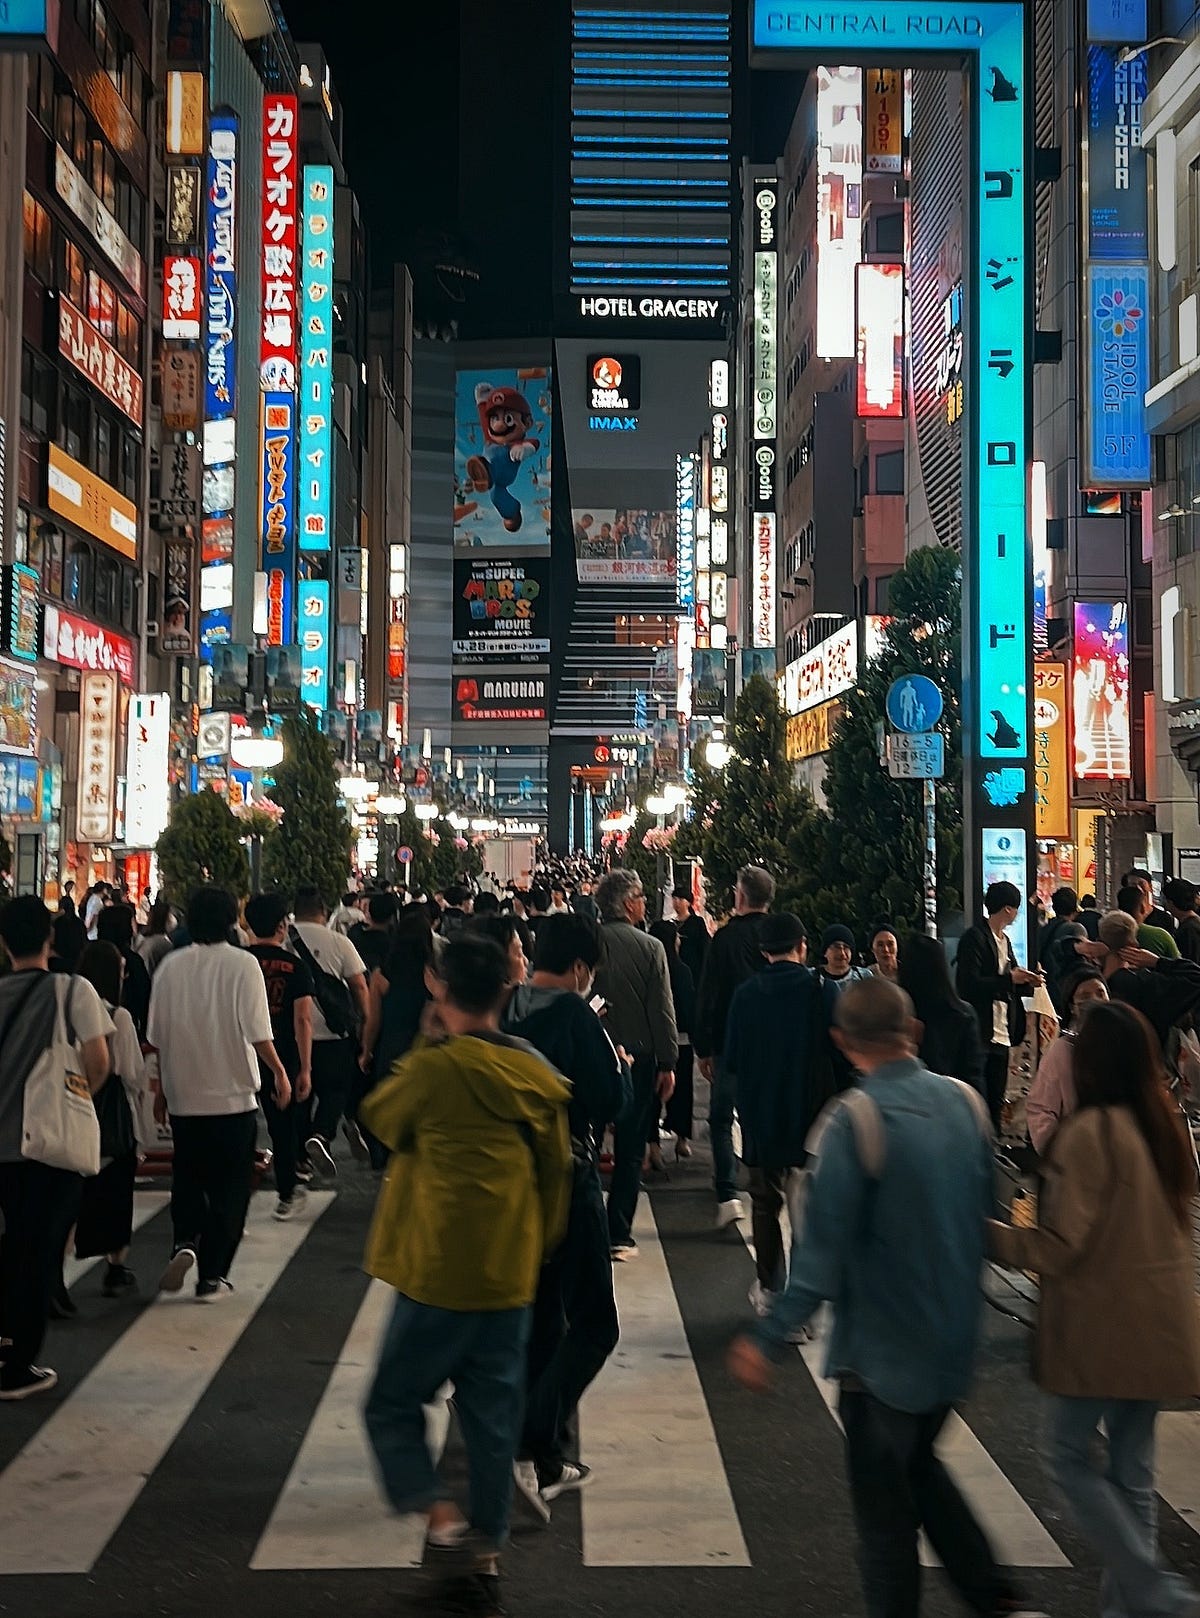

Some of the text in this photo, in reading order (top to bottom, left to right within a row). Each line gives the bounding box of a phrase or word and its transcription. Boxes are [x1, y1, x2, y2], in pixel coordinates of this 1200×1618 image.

[767, 14, 982, 36] CENTRAL ROAD
[1131, 61, 1143, 147] CLUB
[263, 102, 293, 347] カラオケ歌広場
[756, 189, 776, 245] Booth
[580, 297, 719, 318] HOTEL GRACERY
[1103, 342, 1120, 413] STAGE
[1120, 342, 1137, 401] IDOL
[984, 168, 1021, 648] ゴジラロード
[588, 416, 637, 431] IMAX
[1103, 434, 1136, 456] 5F
[756, 446, 775, 500] Booth
[485, 567, 525, 580] SUPER
[463, 579, 540, 600] MARIO
[494, 619, 531, 630] MOVIE
[483, 680, 544, 698] MARUHAN
